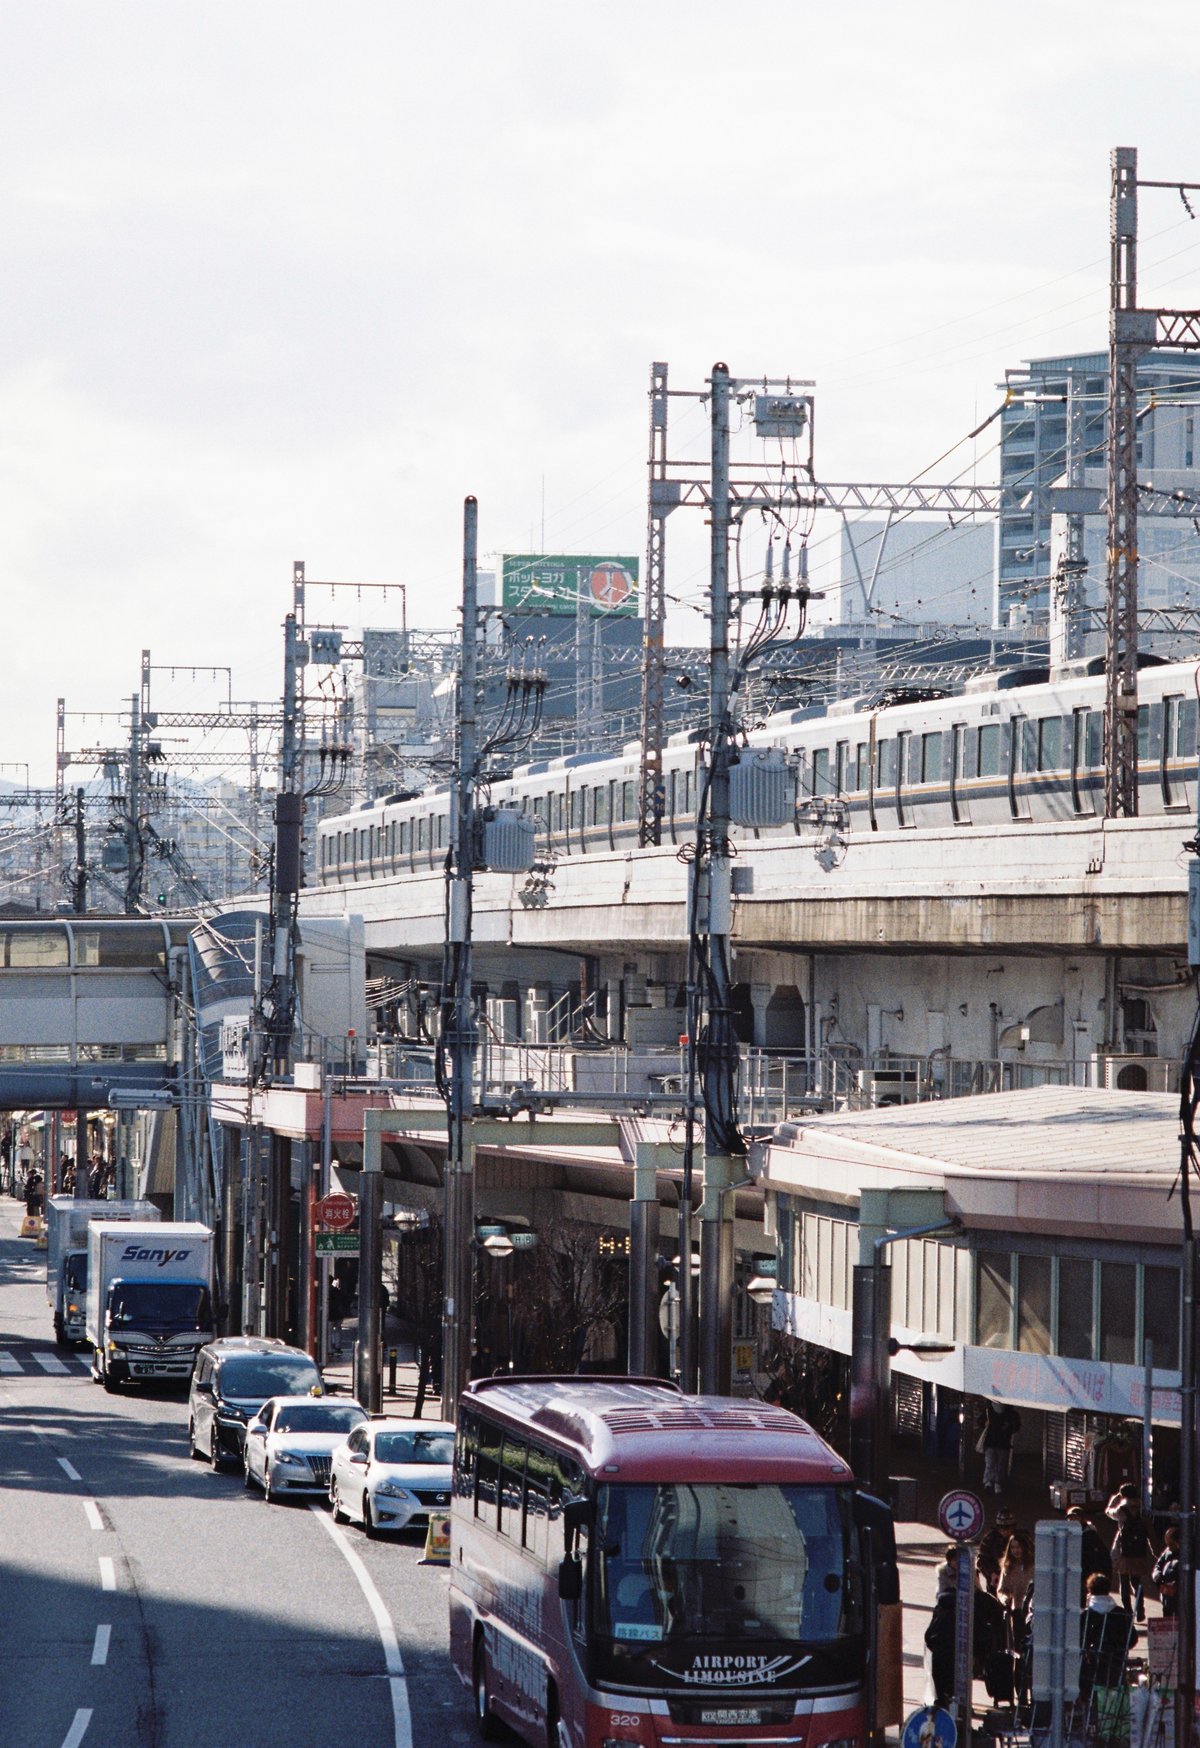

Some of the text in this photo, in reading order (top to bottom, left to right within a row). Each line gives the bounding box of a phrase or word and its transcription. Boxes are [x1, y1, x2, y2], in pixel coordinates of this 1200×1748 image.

[508, 571, 565, 583] ホットヨガ
[325, 1208, 350, 1220] 消火栓
[121, 1245, 192, 1267] Sanyo
[692, 1655, 768, 1669] AIRPORT
[683, 1670, 776, 1684] LIMOUSINE
[610, 1714, 641, 1726] 320
